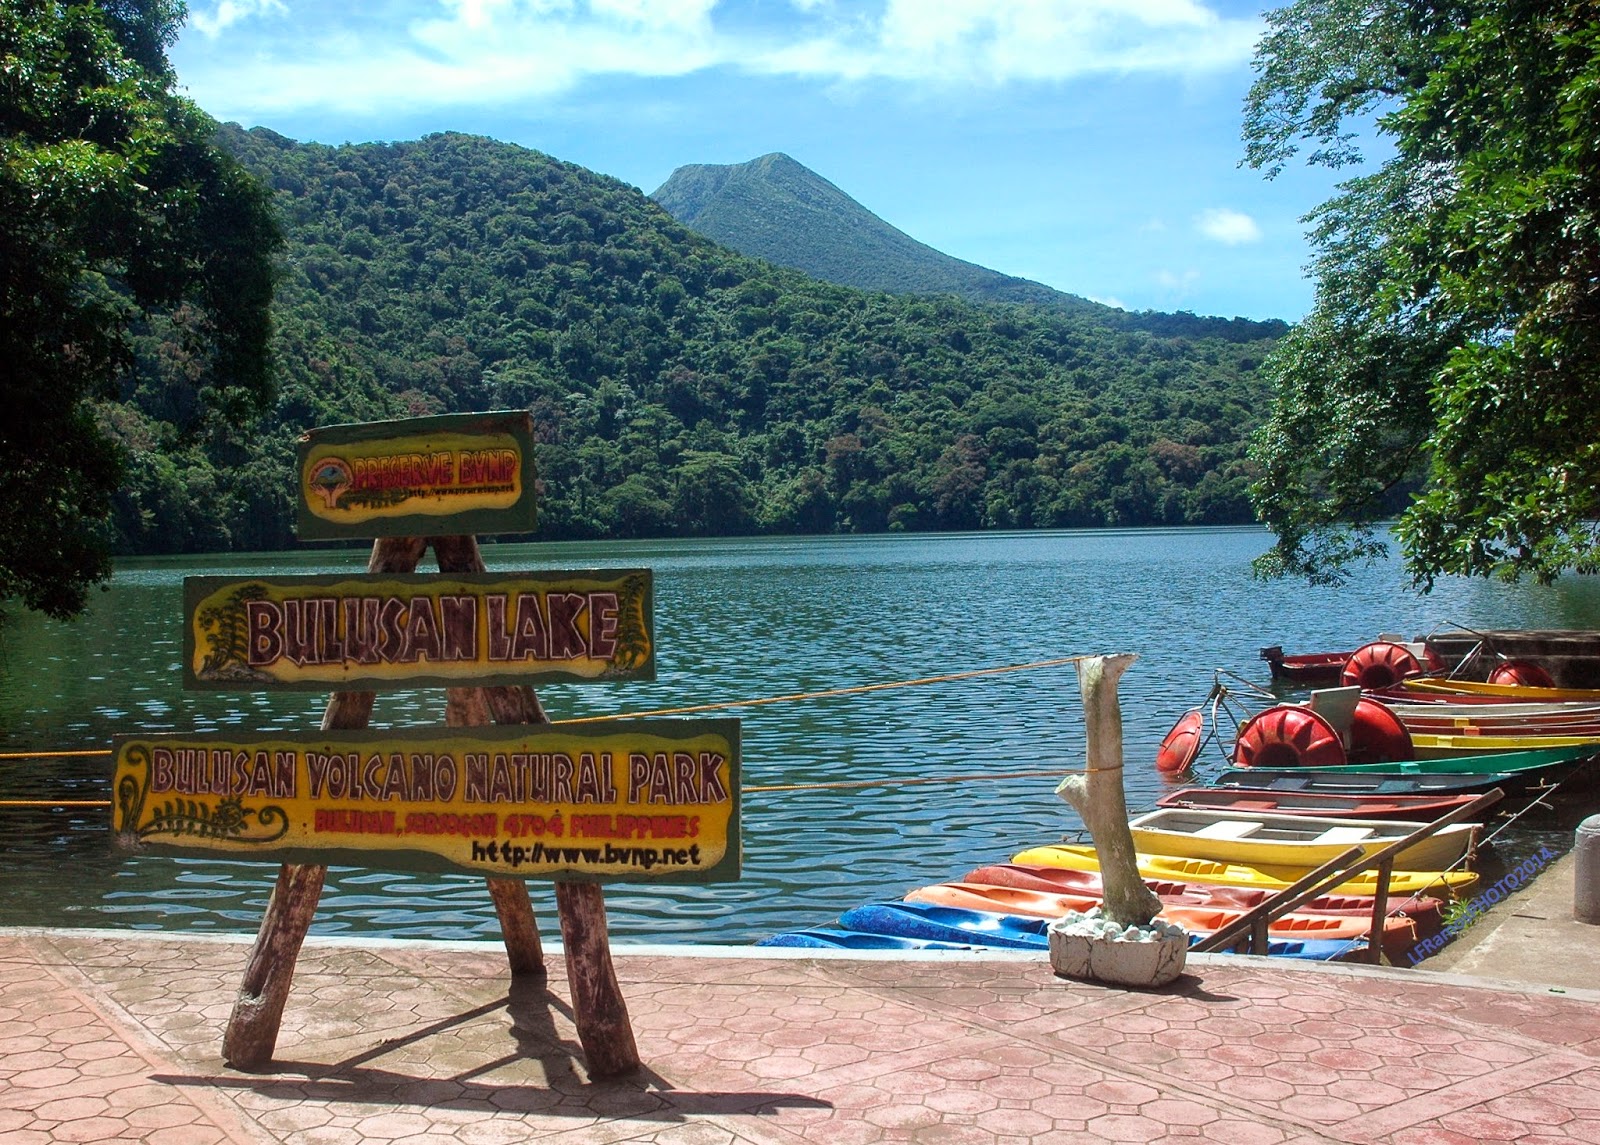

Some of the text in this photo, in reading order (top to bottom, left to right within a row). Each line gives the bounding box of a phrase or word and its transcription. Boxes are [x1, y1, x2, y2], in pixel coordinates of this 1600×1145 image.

[352, 451, 453, 491] PRESERVE
[459, 449, 516, 483] BVNP
[246, 593, 619, 665] BULUSAN LAKE
[152, 749, 728, 805] BULUSAN VOLCANO NATURAL PARK
[503, 813, 564, 838] 4704
[570, 814, 699, 839] PHILIPPINES
[472, 840, 701, 869] http://www.bvnp.net
